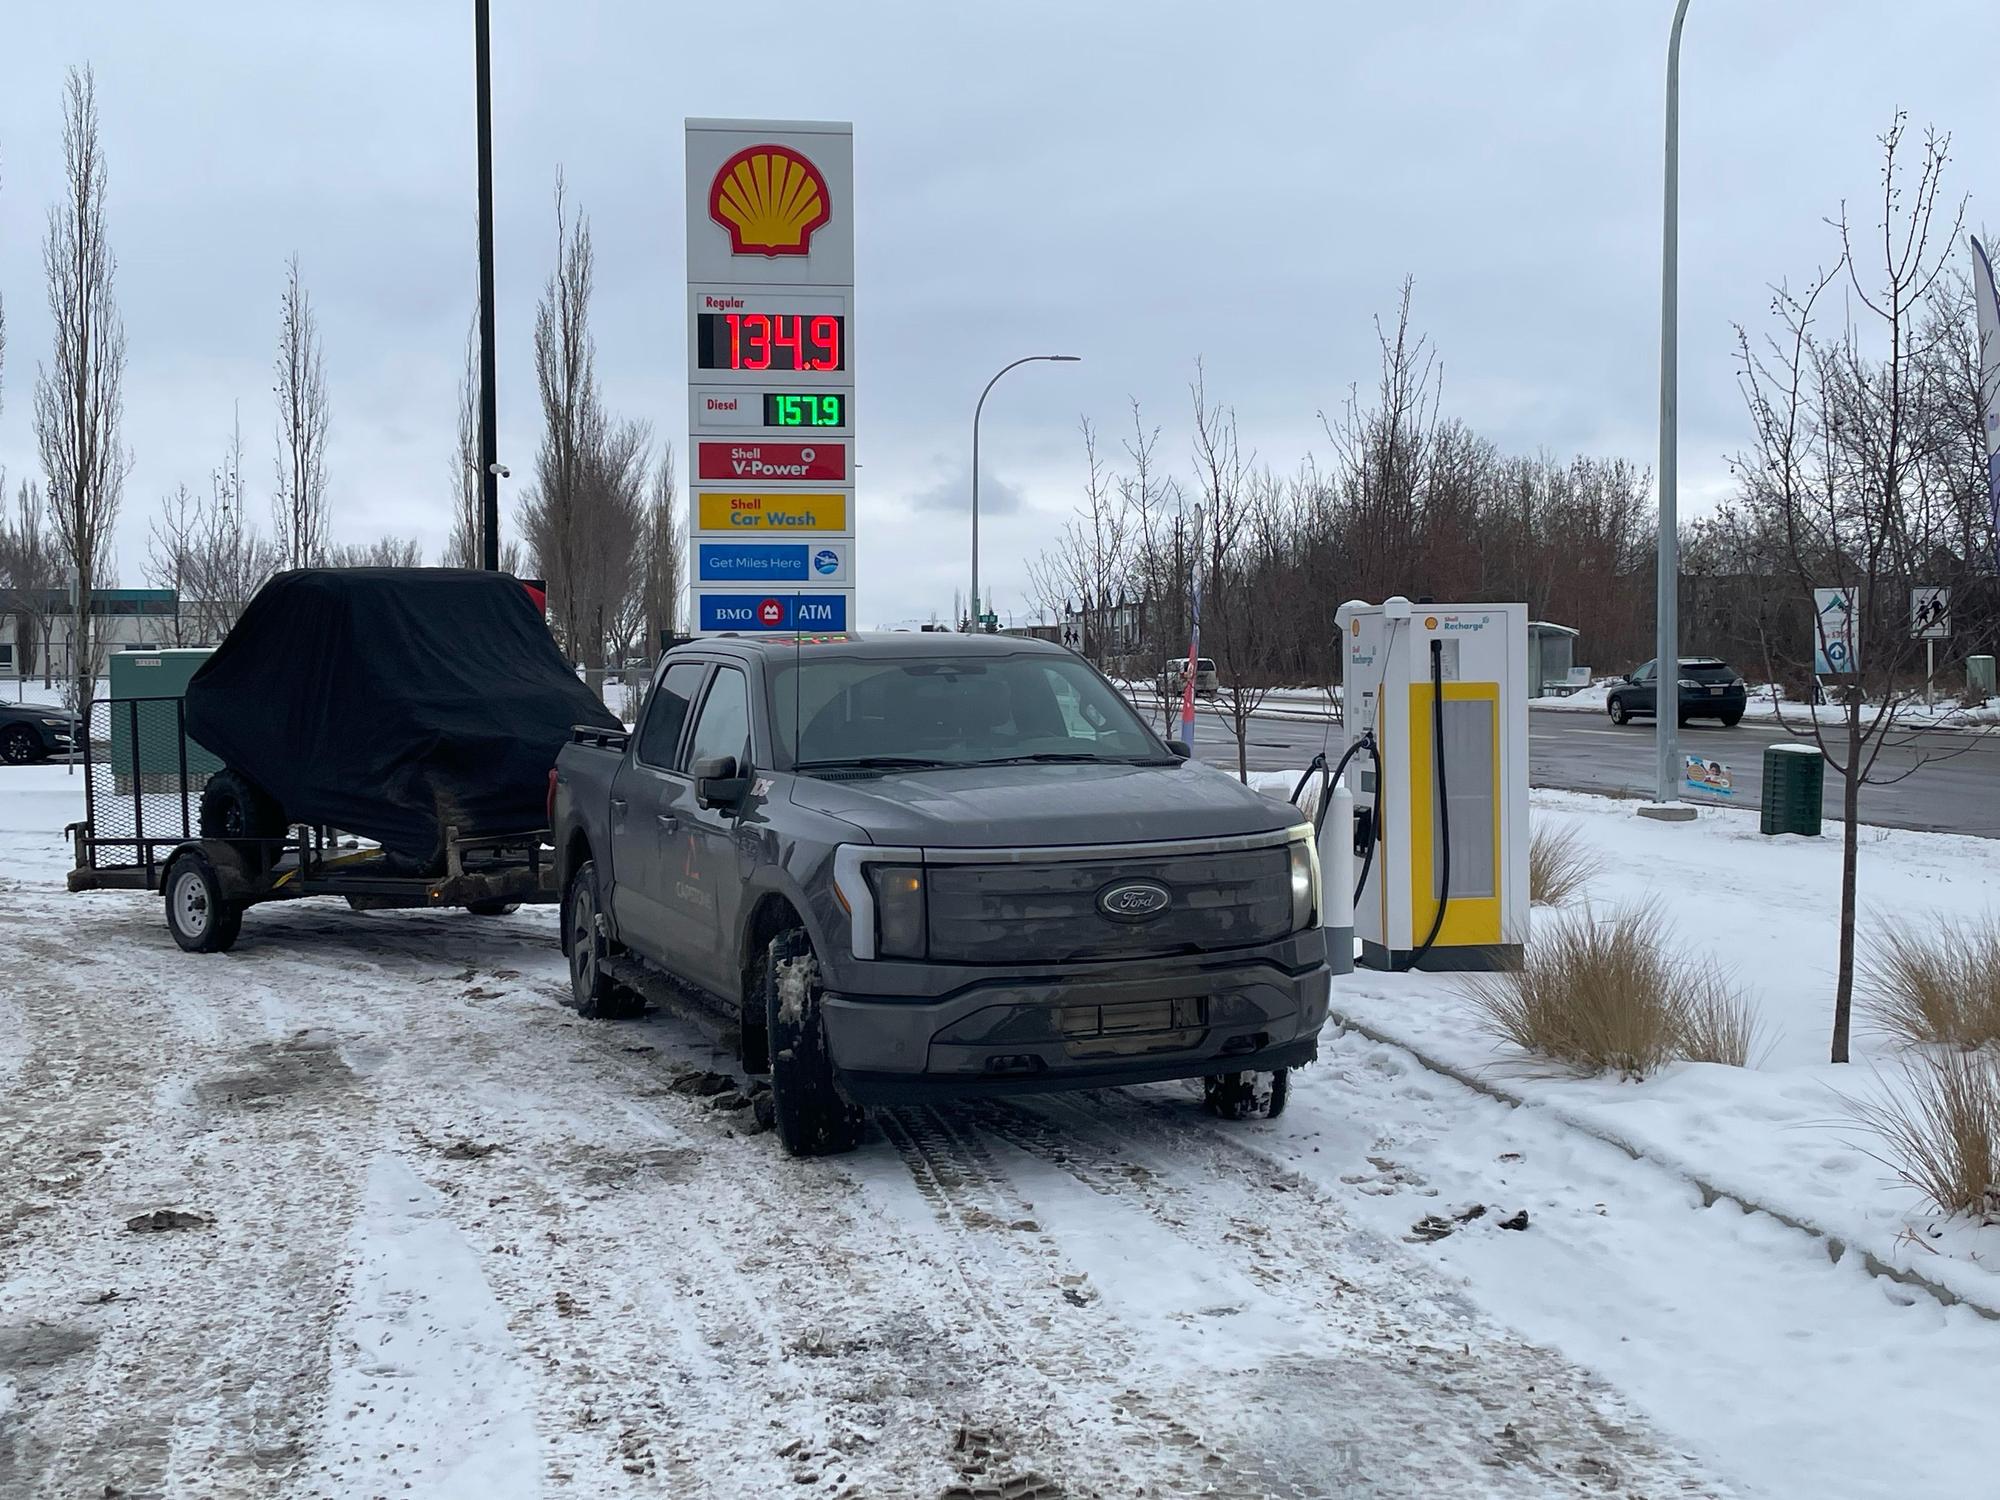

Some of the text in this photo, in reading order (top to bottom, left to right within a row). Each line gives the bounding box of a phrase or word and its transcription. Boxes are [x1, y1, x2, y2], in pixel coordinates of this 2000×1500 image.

[706, 296, 745, 311] Regular
[725, 313, 839, 371] 134.9
[707, 398, 738, 410] Diesel
[776, 396, 839, 425] 157.9
[731, 448, 761, 459] Shell
[732, 461, 809, 476] V-Power
[731, 499, 761, 510] Shell
[731, 511, 816, 526] Car Wash
[709, 557, 801, 568] Get Miles Here
[716, 604, 832, 620] BMO ATM
[1444, 622, 1484, 631] Recharge
[1120, 892, 1154, 908] Ford
